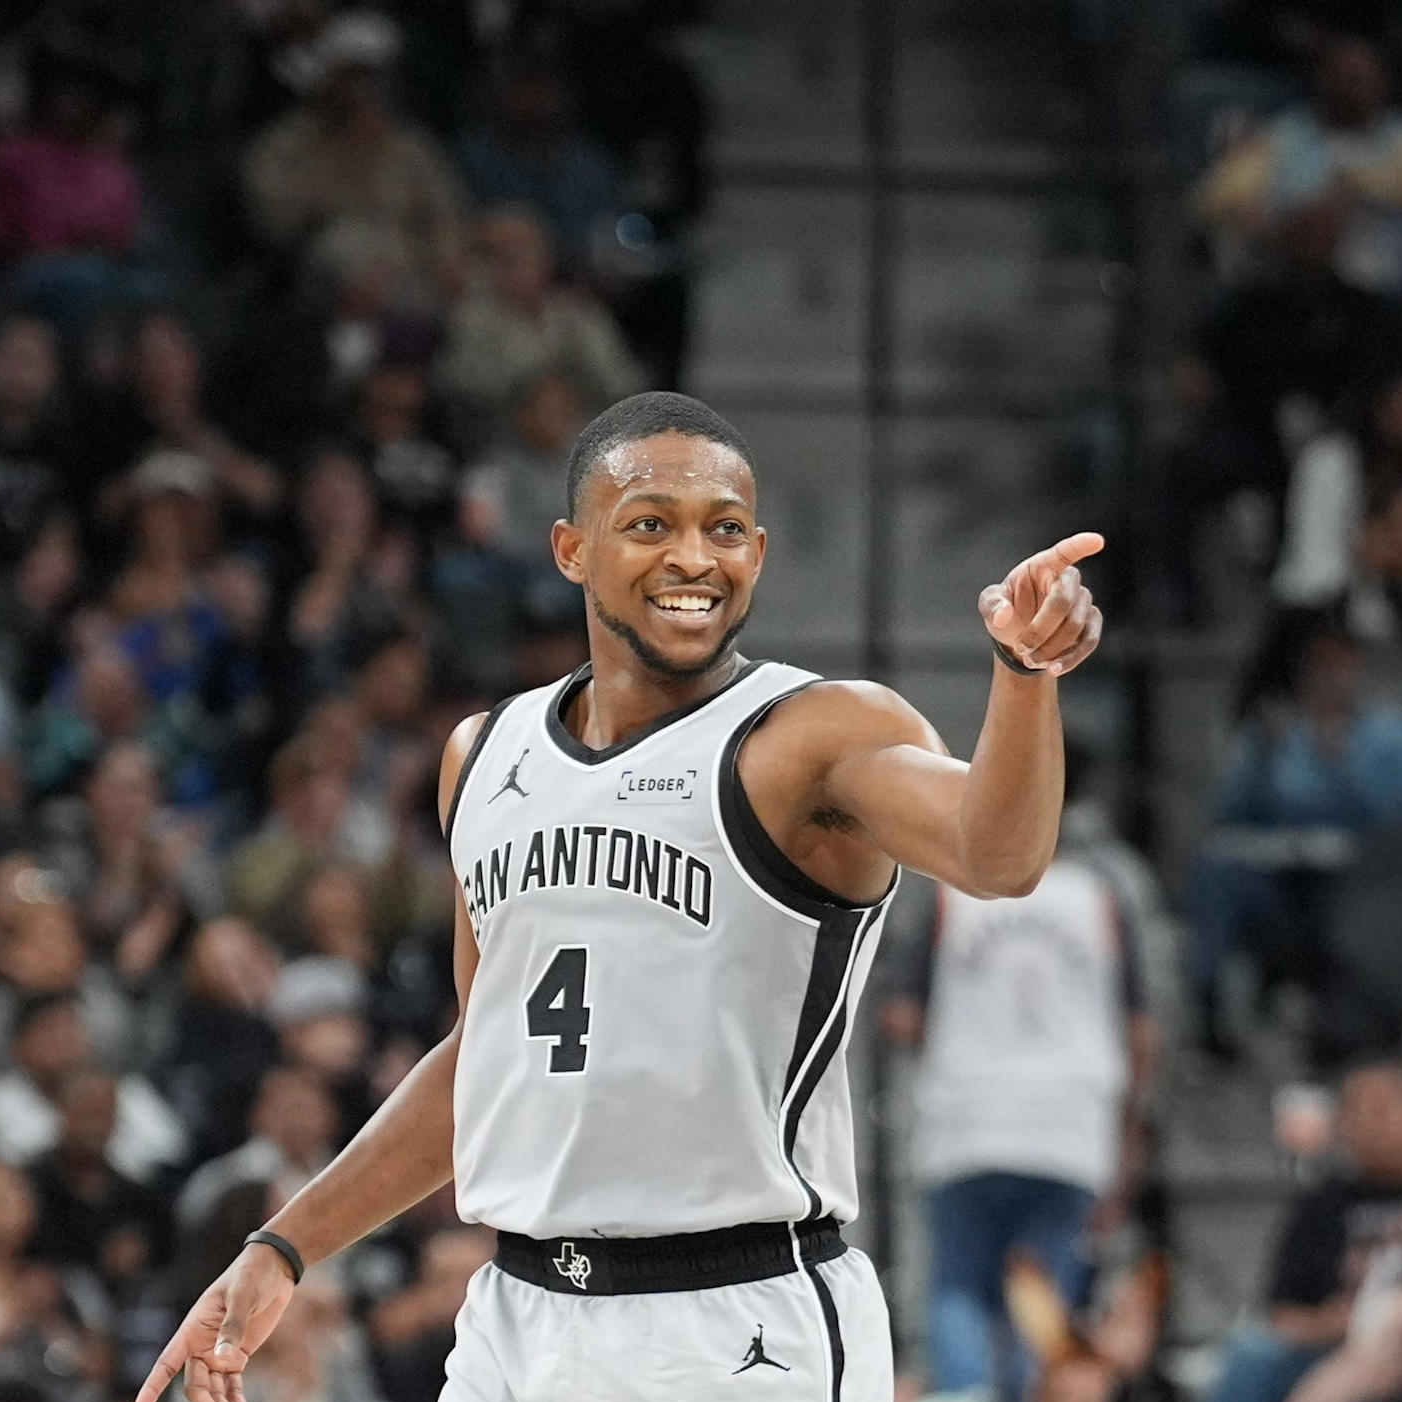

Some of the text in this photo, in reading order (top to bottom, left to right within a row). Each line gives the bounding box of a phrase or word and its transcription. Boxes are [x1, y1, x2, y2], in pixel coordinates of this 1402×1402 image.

[628, 778, 685, 791] LEDGER
[518, 825, 714, 929] ANTONIO
[524, 945, 592, 1075] 4
